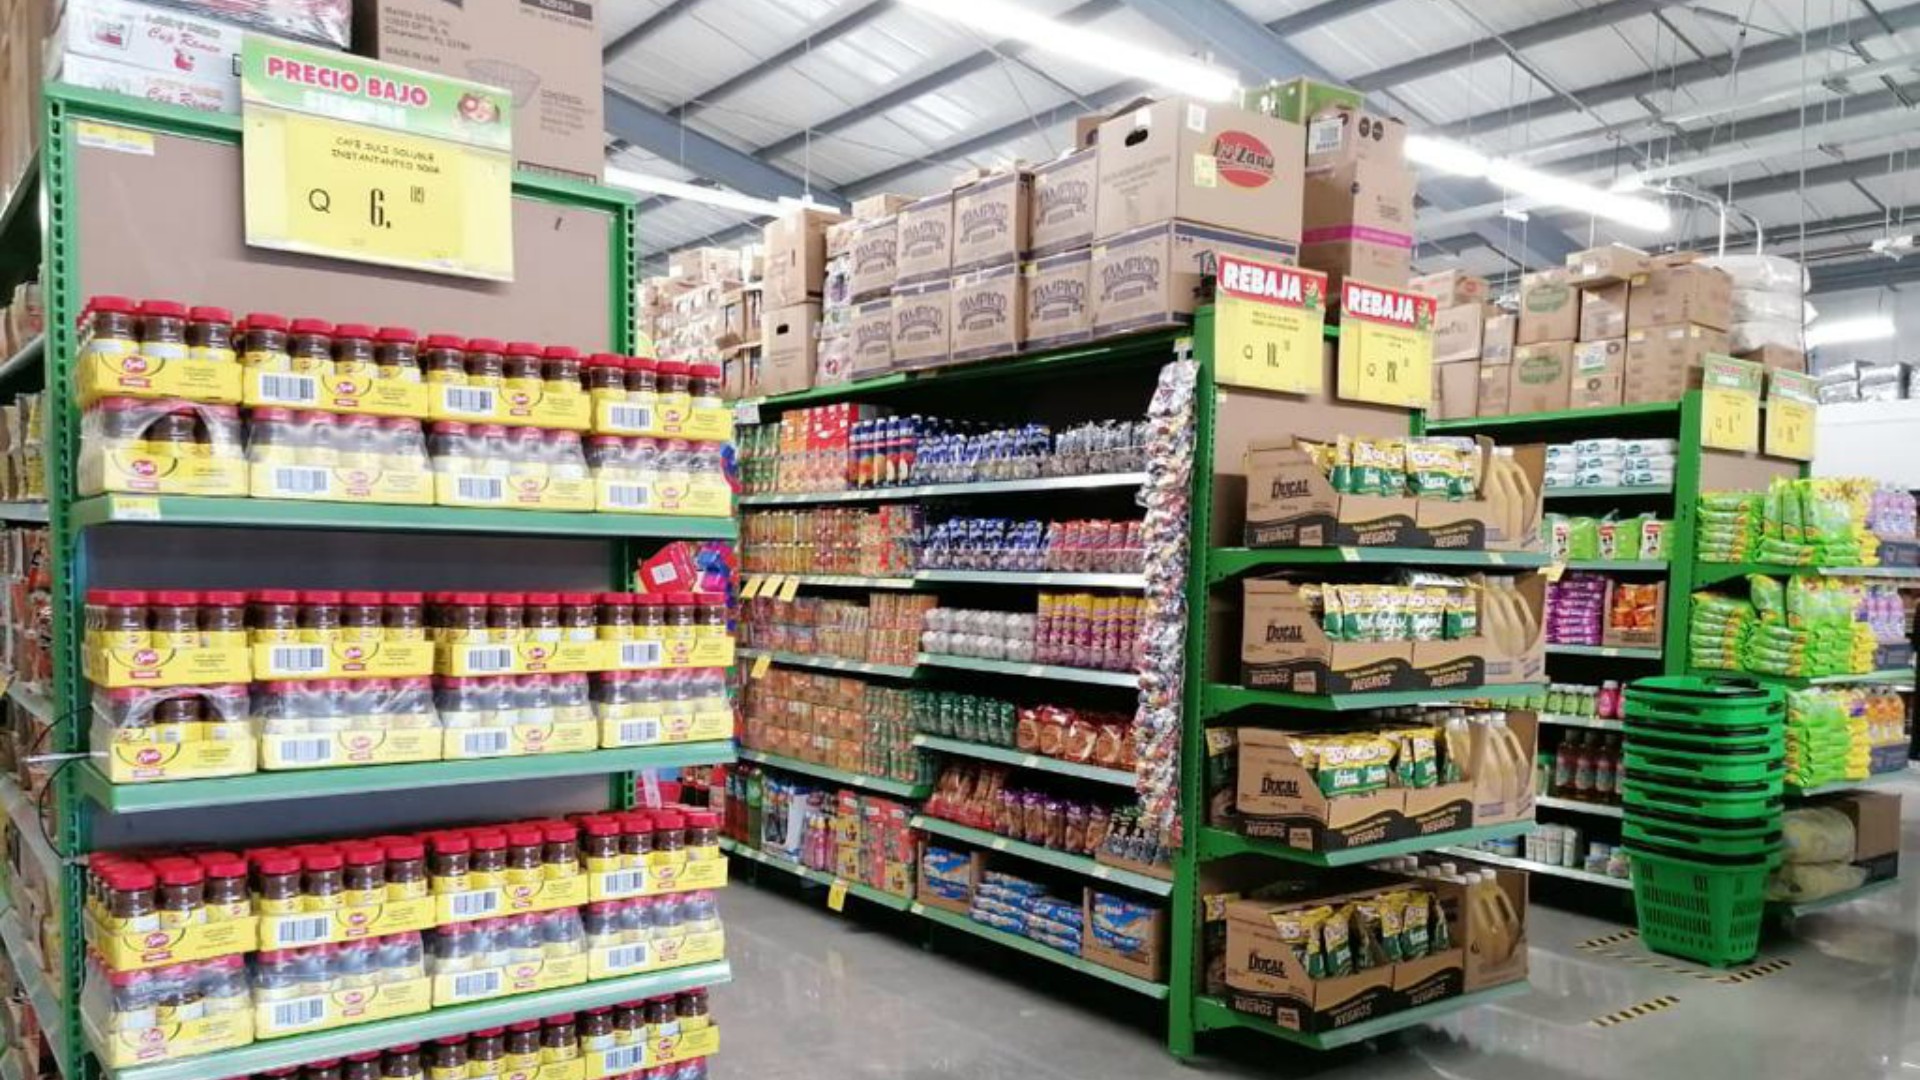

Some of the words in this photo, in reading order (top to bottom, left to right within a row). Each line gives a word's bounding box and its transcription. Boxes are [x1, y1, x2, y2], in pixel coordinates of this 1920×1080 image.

[267, 56, 360, 93] PRECIO
[366, 77, 430, 107] BAJO
[309, 188, 330, 214] Q
[1039, 181, 1088, 207] TAMPICO
[961, 201, 1009, 230] TAMPICO
[1102, 255, 1160, 285] TAMPICO
[1223, 262, 1303, 304] REBAJA
[959, 291, 1008, 318] TAMPICO
[1033, 279, 1086, 306] TAMPICO
[1347, 286, 1416, 323] REBAJA
[1271, 479, 1310, 499] DUCAL
[1358, 529, 1396, 546] NEGROS
[1265, 625, 1304, 643] DUCAL
[1351, 674, 1392, 692] NEGROS
[1430, 670, 1470, 688] NEGROS
[1261, 777, 1300, 796] DUCAL
[1249, 952, 1287, 977] DUCAL
[1334, 1002, 1372, 1028] NEGROS
